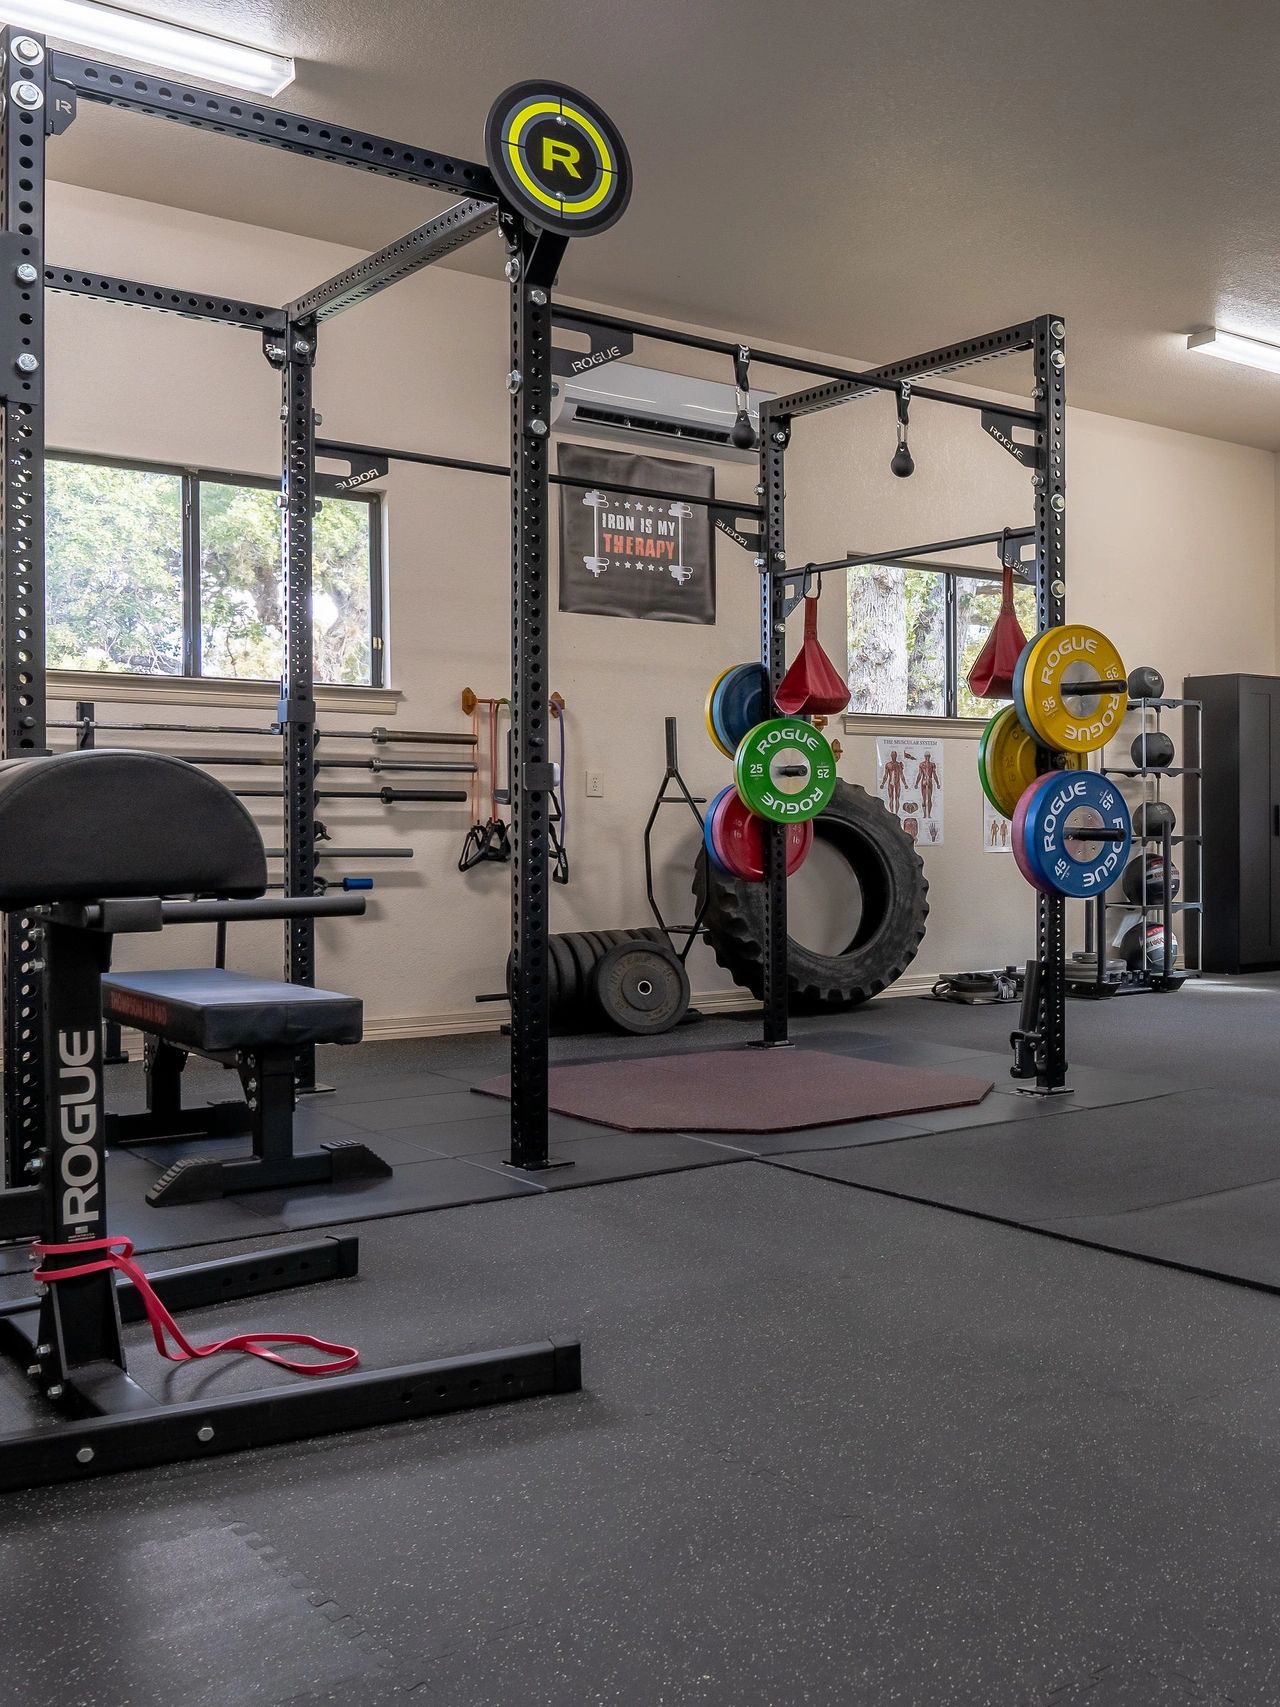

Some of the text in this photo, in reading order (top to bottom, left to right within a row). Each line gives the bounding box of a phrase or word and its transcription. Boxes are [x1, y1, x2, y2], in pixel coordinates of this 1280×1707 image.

[543, 137, 582, 179] R
[571, 346, 621, 372] ROGUE
[989, 425, 1024, 460] ROGUE
[602, 513, 675, 536] IRON IS MY
[603, 533, 675, 560] THERAPY
[1041, 636, 1098, 685] ROGUE
[1042, 696, 1056, 712] 35
[756, 728, 820, 755] ROGUE
[750, 763, 763, 774] 25
[817, 768, 830, 779] 25
[760, 787, 824, 815] ROGUE
[1102, 793, 1114, 811] 45
[1043, 781, 1087, 853] ROGUE
[1054, 858, 1067, 877] 45
[59, 1030, 99, 1225] ROGUE
